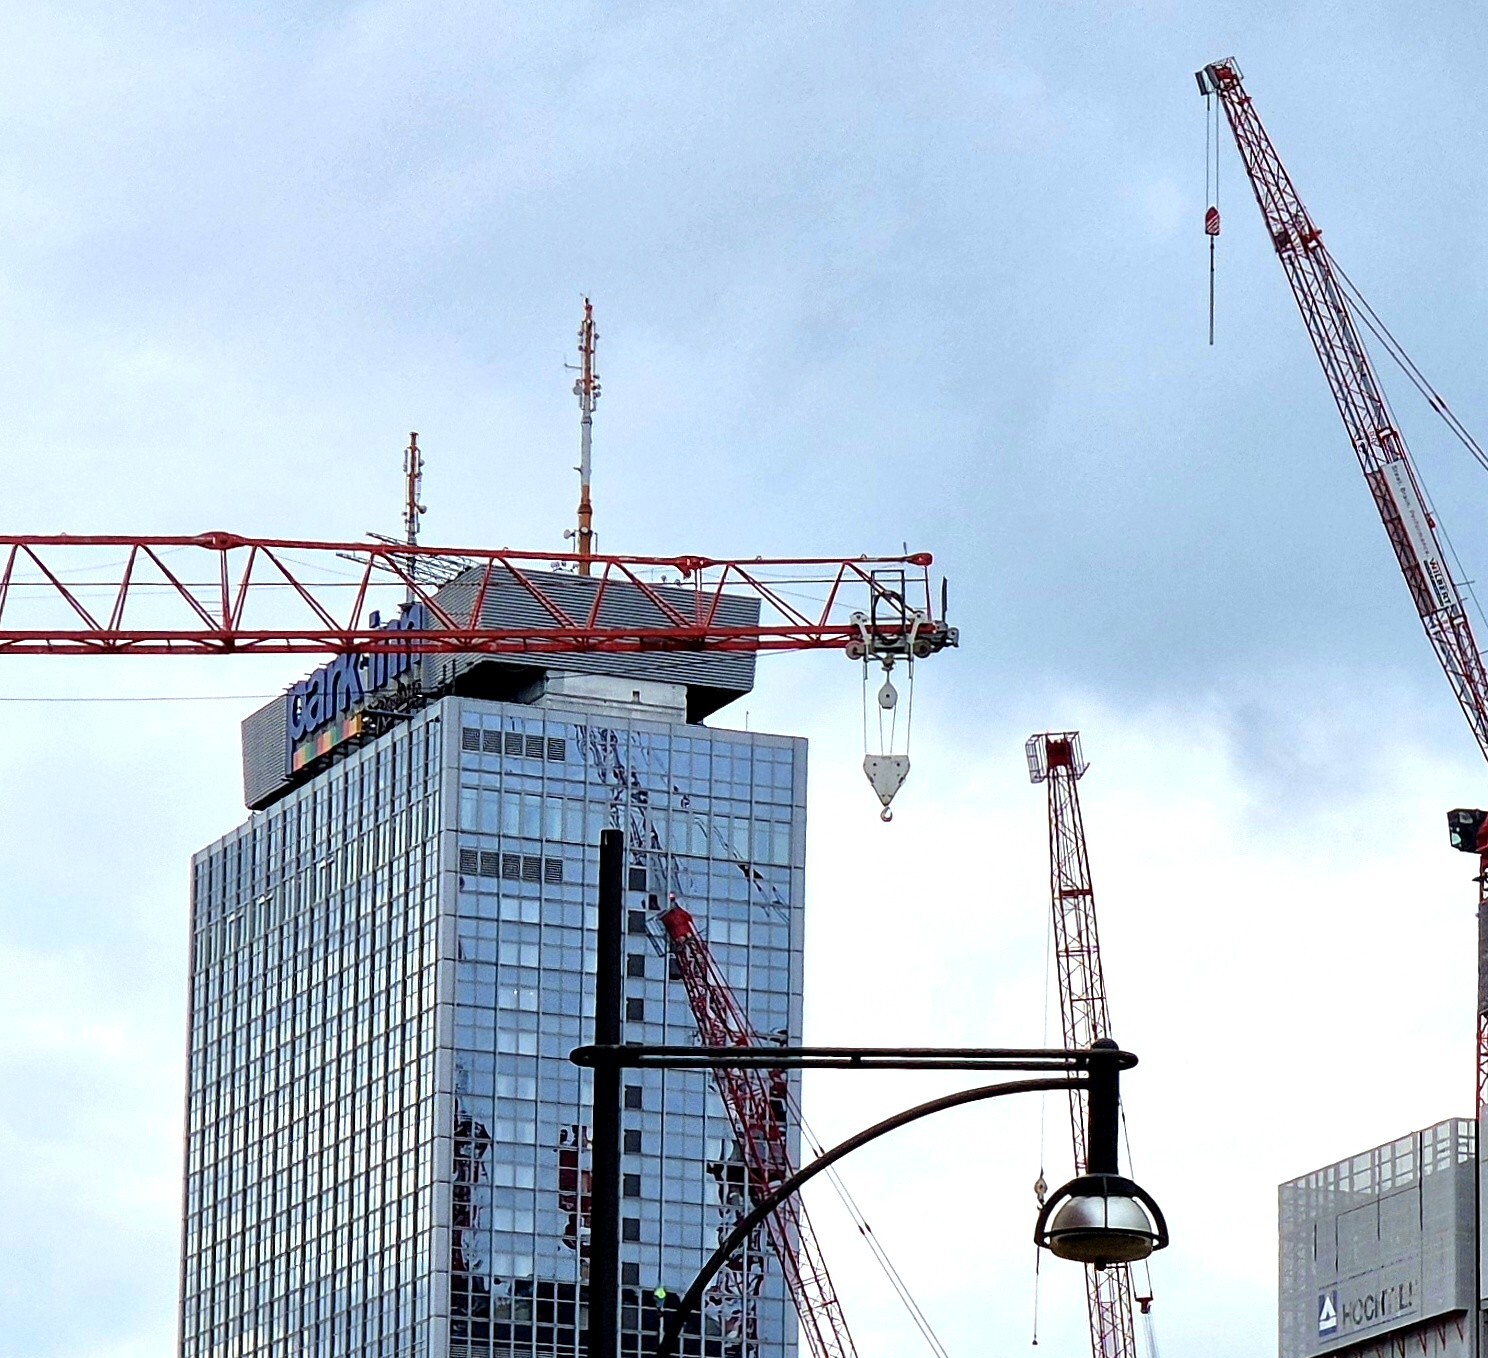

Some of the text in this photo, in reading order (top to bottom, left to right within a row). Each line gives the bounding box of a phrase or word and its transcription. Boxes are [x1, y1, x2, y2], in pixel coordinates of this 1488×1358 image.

[1429, 556, 1452, 604] WILBERT
[286, 603, 424, 777] park inn
